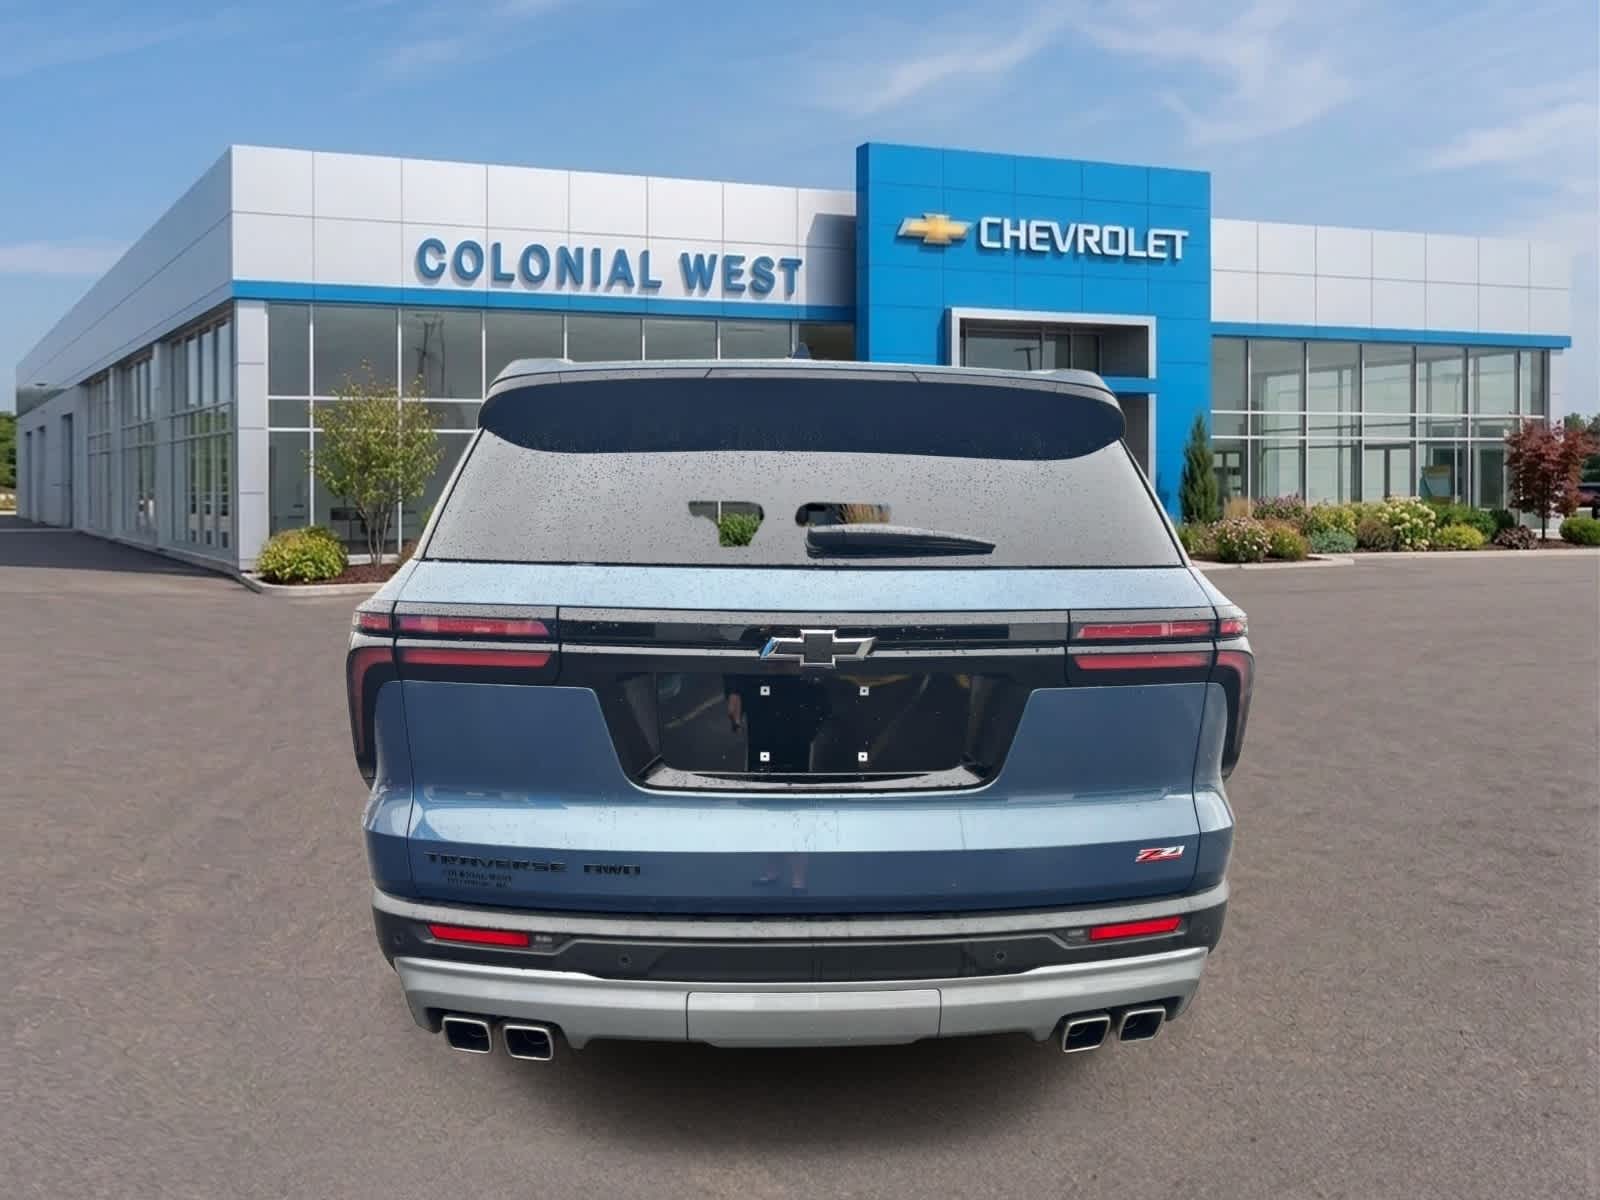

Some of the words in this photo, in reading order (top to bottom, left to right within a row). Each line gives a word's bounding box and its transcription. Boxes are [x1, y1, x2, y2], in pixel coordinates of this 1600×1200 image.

[979, 215, 1190, 262] CHEVROLET
[415, 238, 663, 291] COLONIAL
[679, 252, 803, 300] WEST
[424, 851, 567, 873] TRAVERSE
